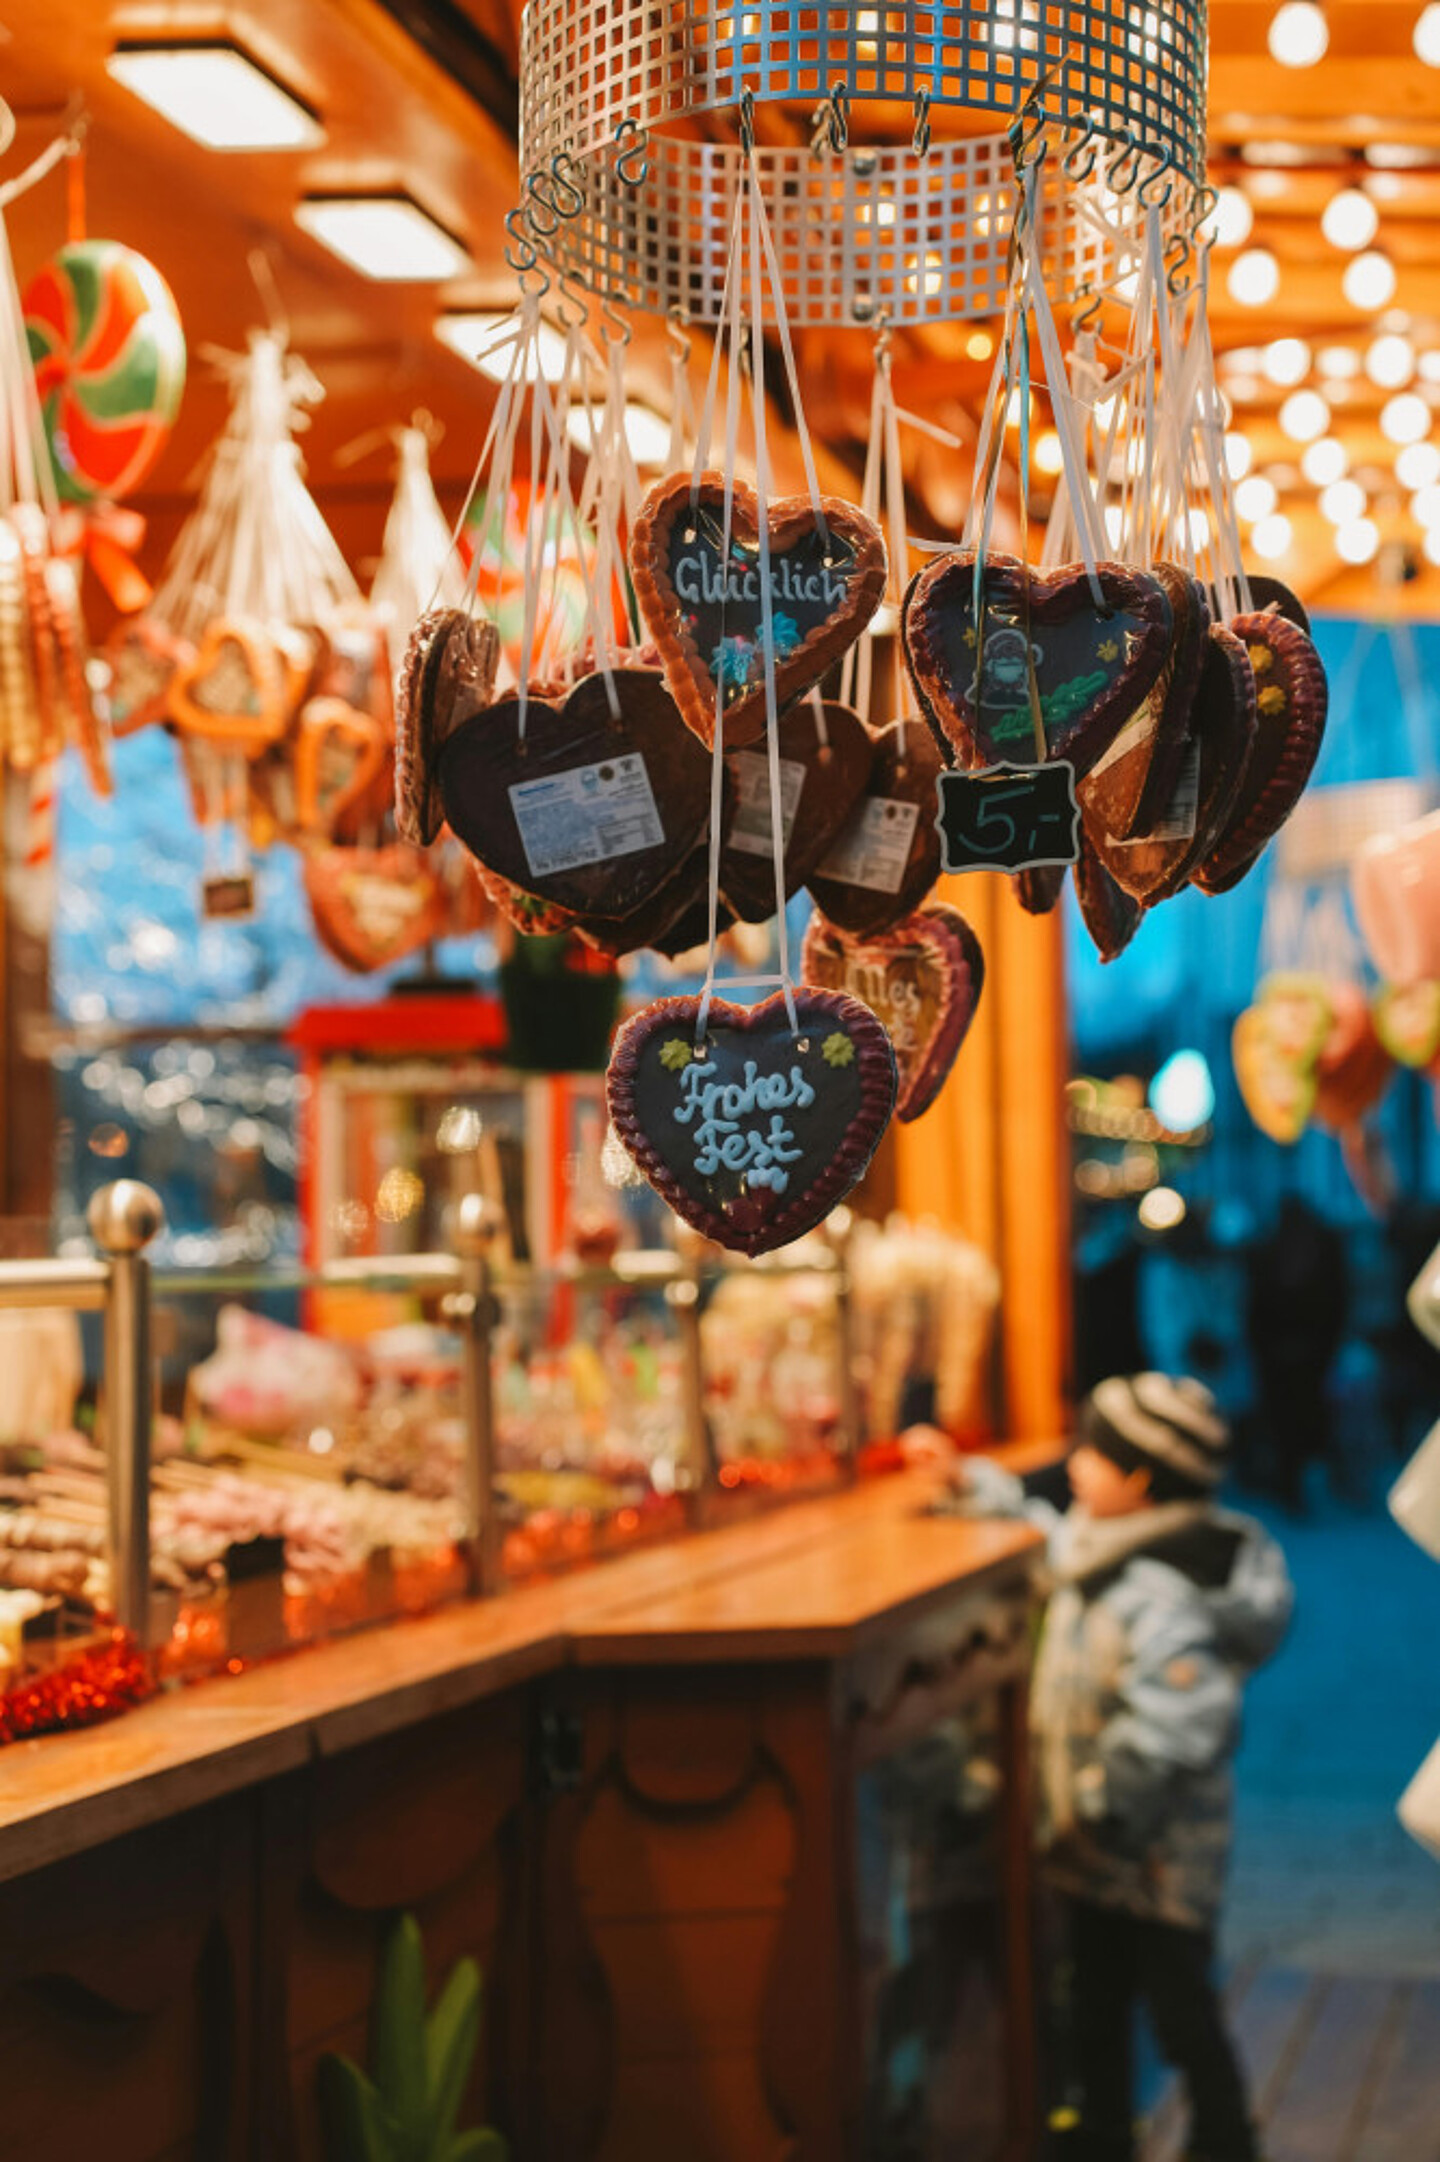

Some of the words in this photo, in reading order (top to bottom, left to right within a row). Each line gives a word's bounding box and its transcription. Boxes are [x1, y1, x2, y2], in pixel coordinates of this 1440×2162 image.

[957, 785, 1061, 855] 5,-
[673, 1060, 816, 1124] Frohes
[693, 1115, 803, 1176] Fest
